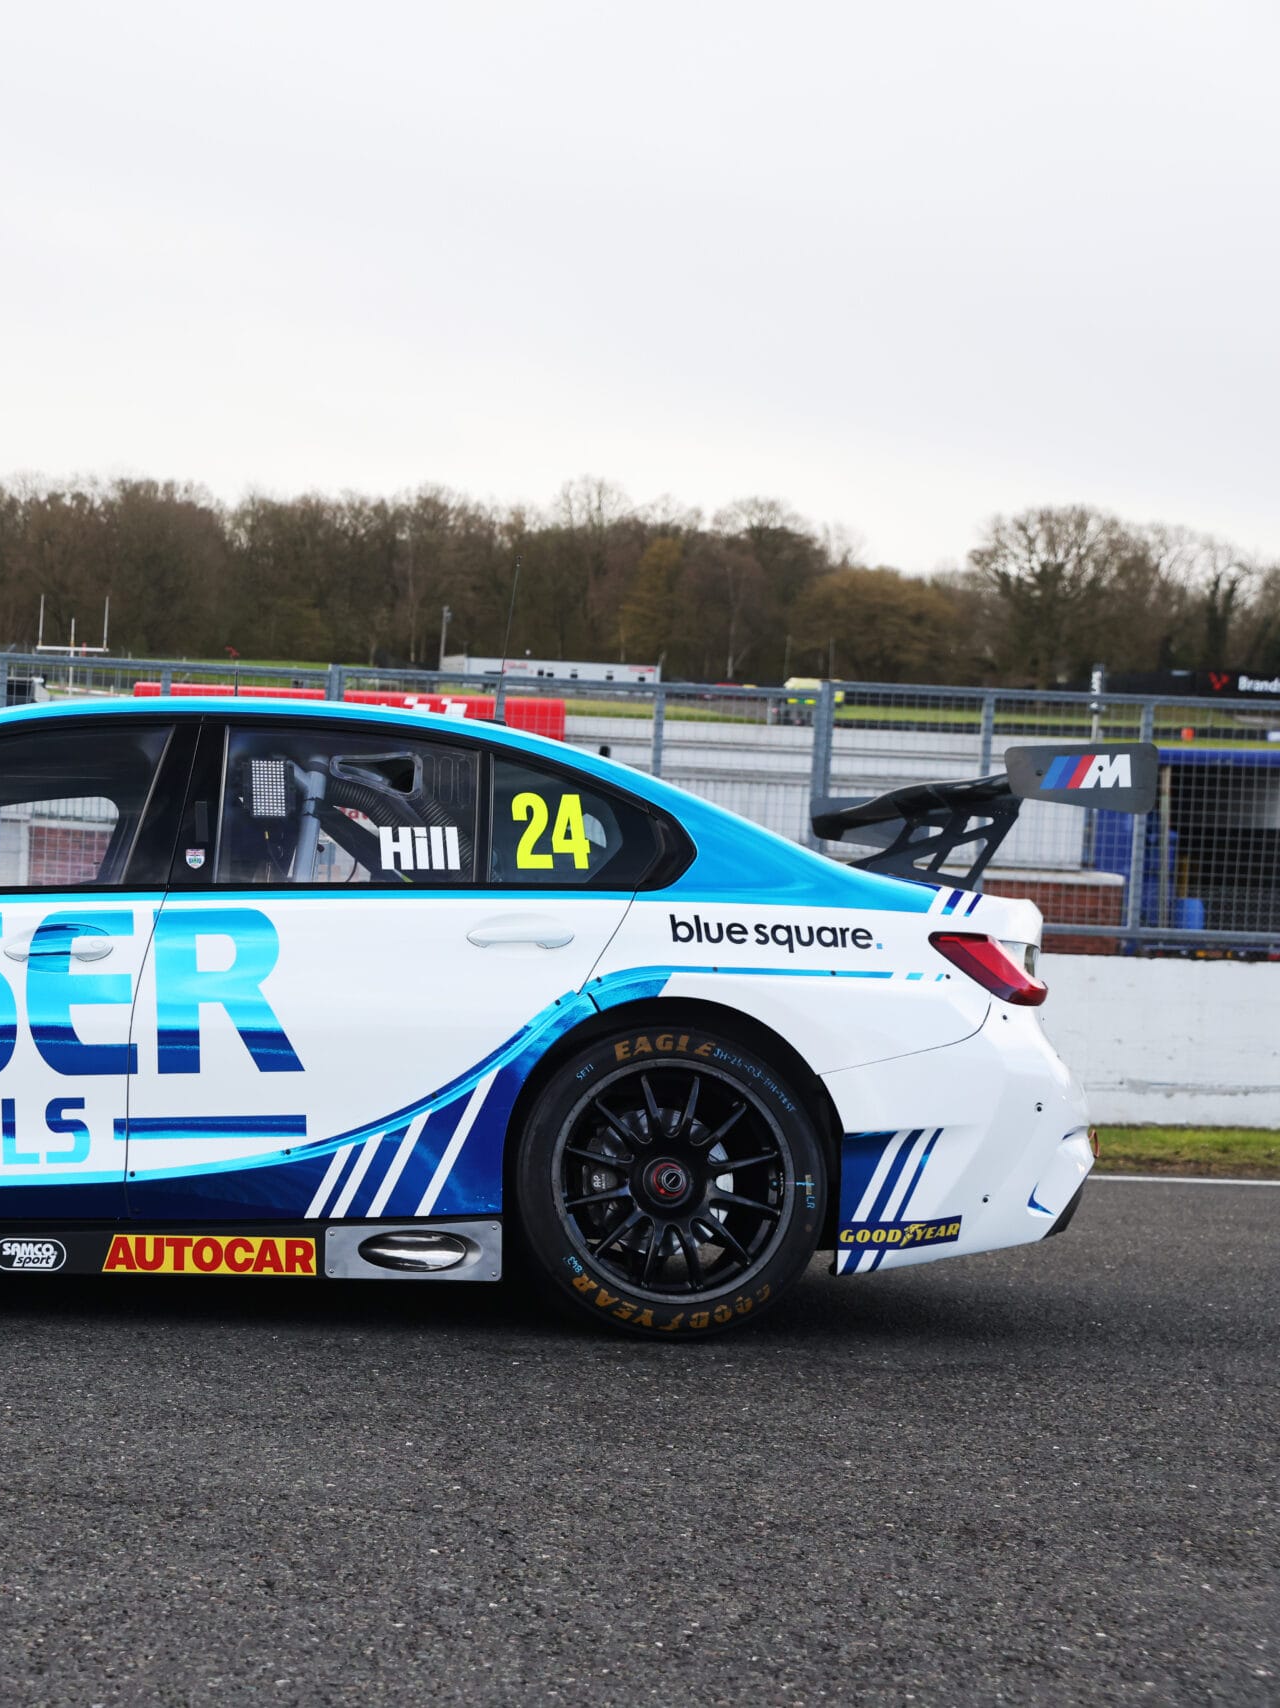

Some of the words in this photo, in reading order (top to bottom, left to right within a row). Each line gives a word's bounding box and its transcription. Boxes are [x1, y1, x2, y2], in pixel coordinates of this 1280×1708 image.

[1238, 674, 1280, 694] Brand
[511, 792, 590, 869] 24
[378, 826, 461, 870] Hill
[669, 914, 748, 945] blue
[613, 1034, 716, 1061] EAGLE
[2, 1242, 58, 1256] SAMCO
[15, 1254, 53, 1267] sport
[103, 1236, 314, 1273] AUTOCAR
